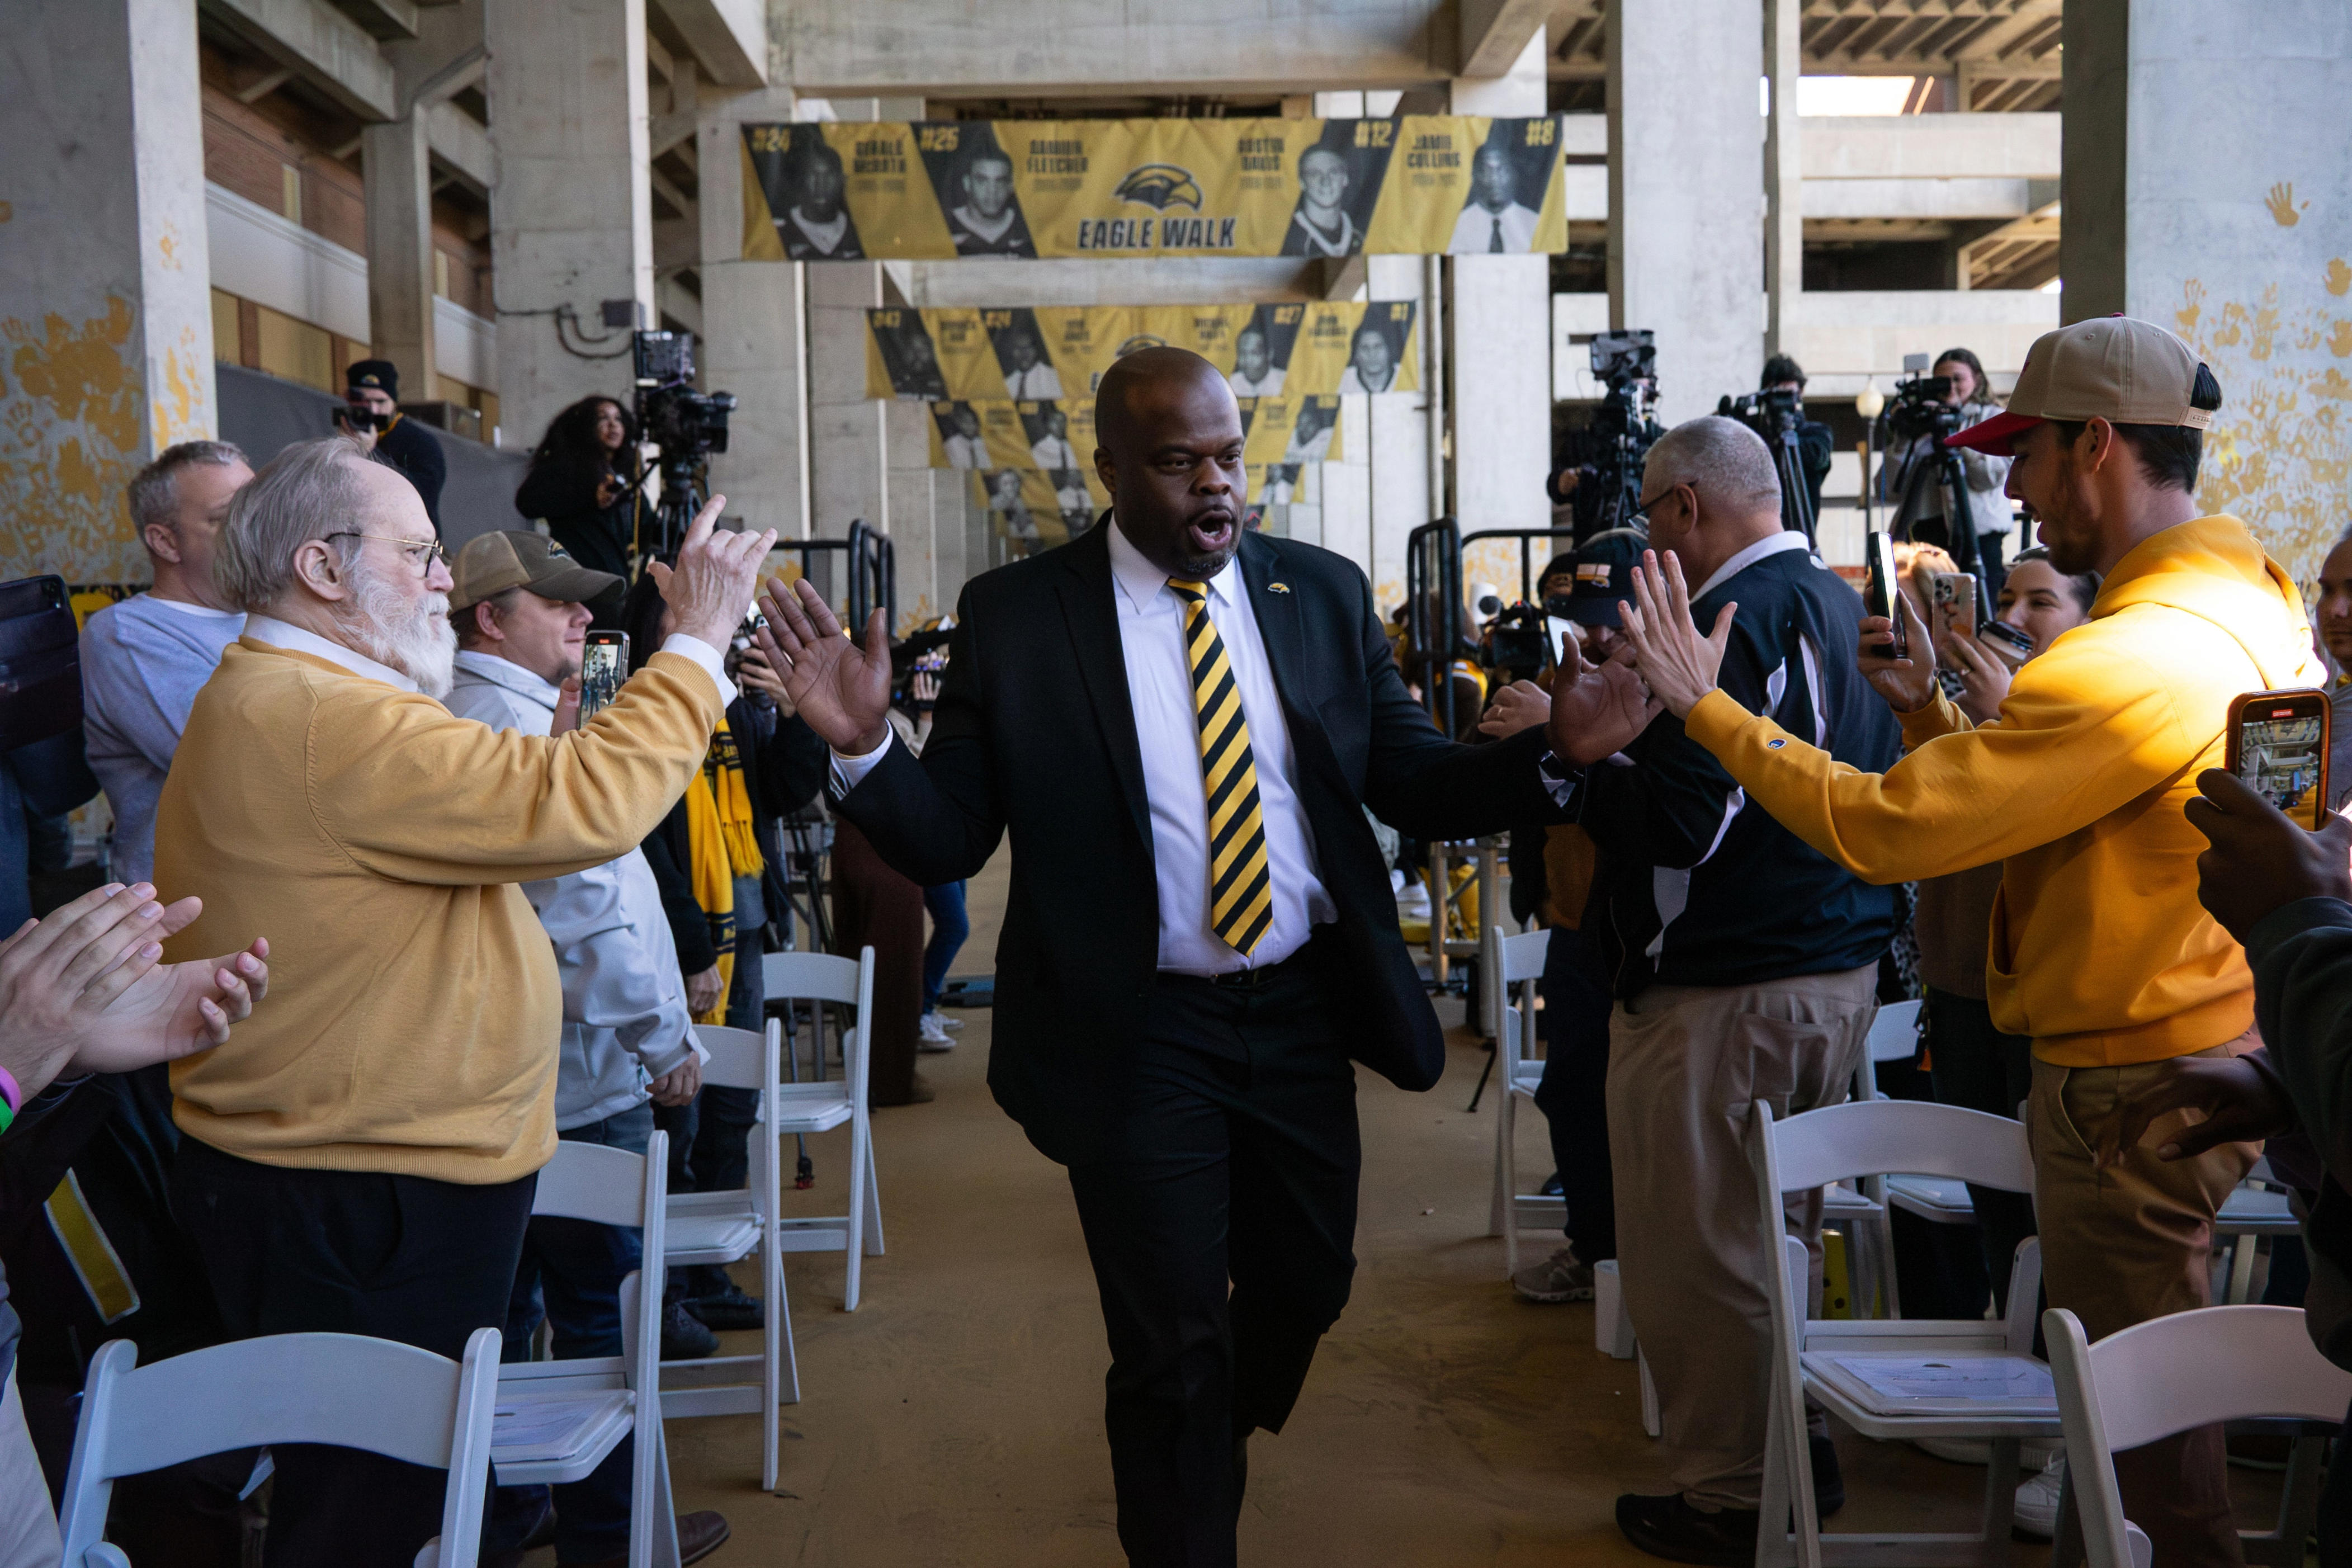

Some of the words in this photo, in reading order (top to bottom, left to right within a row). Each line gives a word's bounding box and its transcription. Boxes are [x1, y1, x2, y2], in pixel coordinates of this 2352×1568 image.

[1353, 120, 1393, 148] #12
[1526, 119, 1556, 147] #8
[1077, 218, 1154, 249] EAGLE
[1160, 216, 1237, 248] WALK
